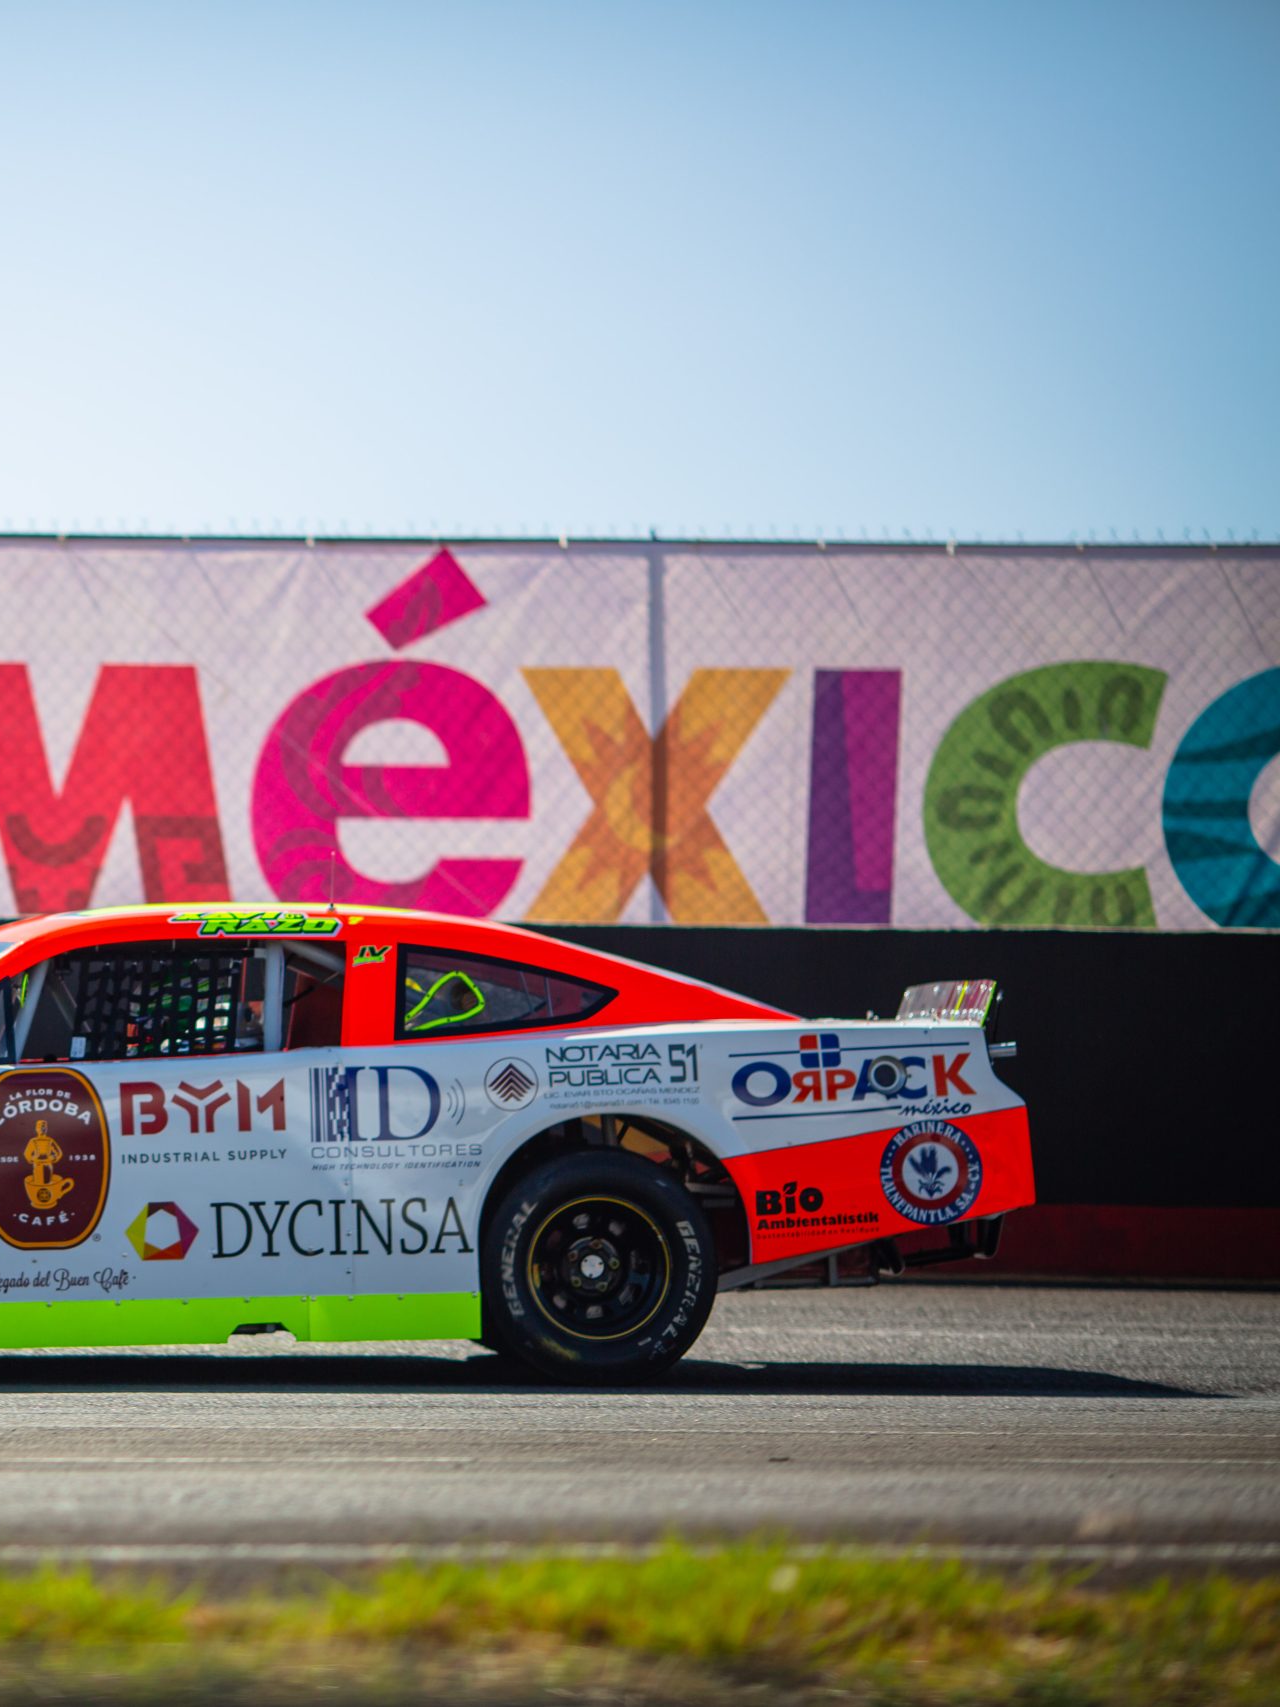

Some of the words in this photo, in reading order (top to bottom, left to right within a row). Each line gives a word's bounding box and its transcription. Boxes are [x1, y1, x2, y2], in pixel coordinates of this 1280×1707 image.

[200, 918, 341, 935] RAZO
[545, 1043, 661, 1063] NOTARIA
[668, 1043, 698, 1083] 51
[548, 1067, 662, 1088] PUBLICA
[9, 1092, 23, 1101] LA
[25, 1088, 54, 1097] FLOR
[56, 1090, 71, 1099] DE
[119, 1077, 287, 1136] BYM
[899, 1098, 972, 1116] méxico
[893, 1121, 962, 1146] HARINERA
[121, 1151, 220, 1165] INDUSTRIAL
[228, 1148, 287, 1161] SUPPLY
[311, 1143, 483, 1159] CONSULTORES
[339, 1162, 401, 1171] TECHNOLOGY
[404, 1160, 481, 1169] IDENTIFICATION
[18, 1210, 70, 1227] CAFÉ
[209, 1197, 475, 1259] DYCINSA
[757, 1211, 880, 1231] Ambientalistik
[500, 1200, 540, 1318] GENERAL
[32, 1271, 51, 1288] del
[53, 1267, 90, 1292] Buen
[661, 1220, 703, 1339] GENERAL
